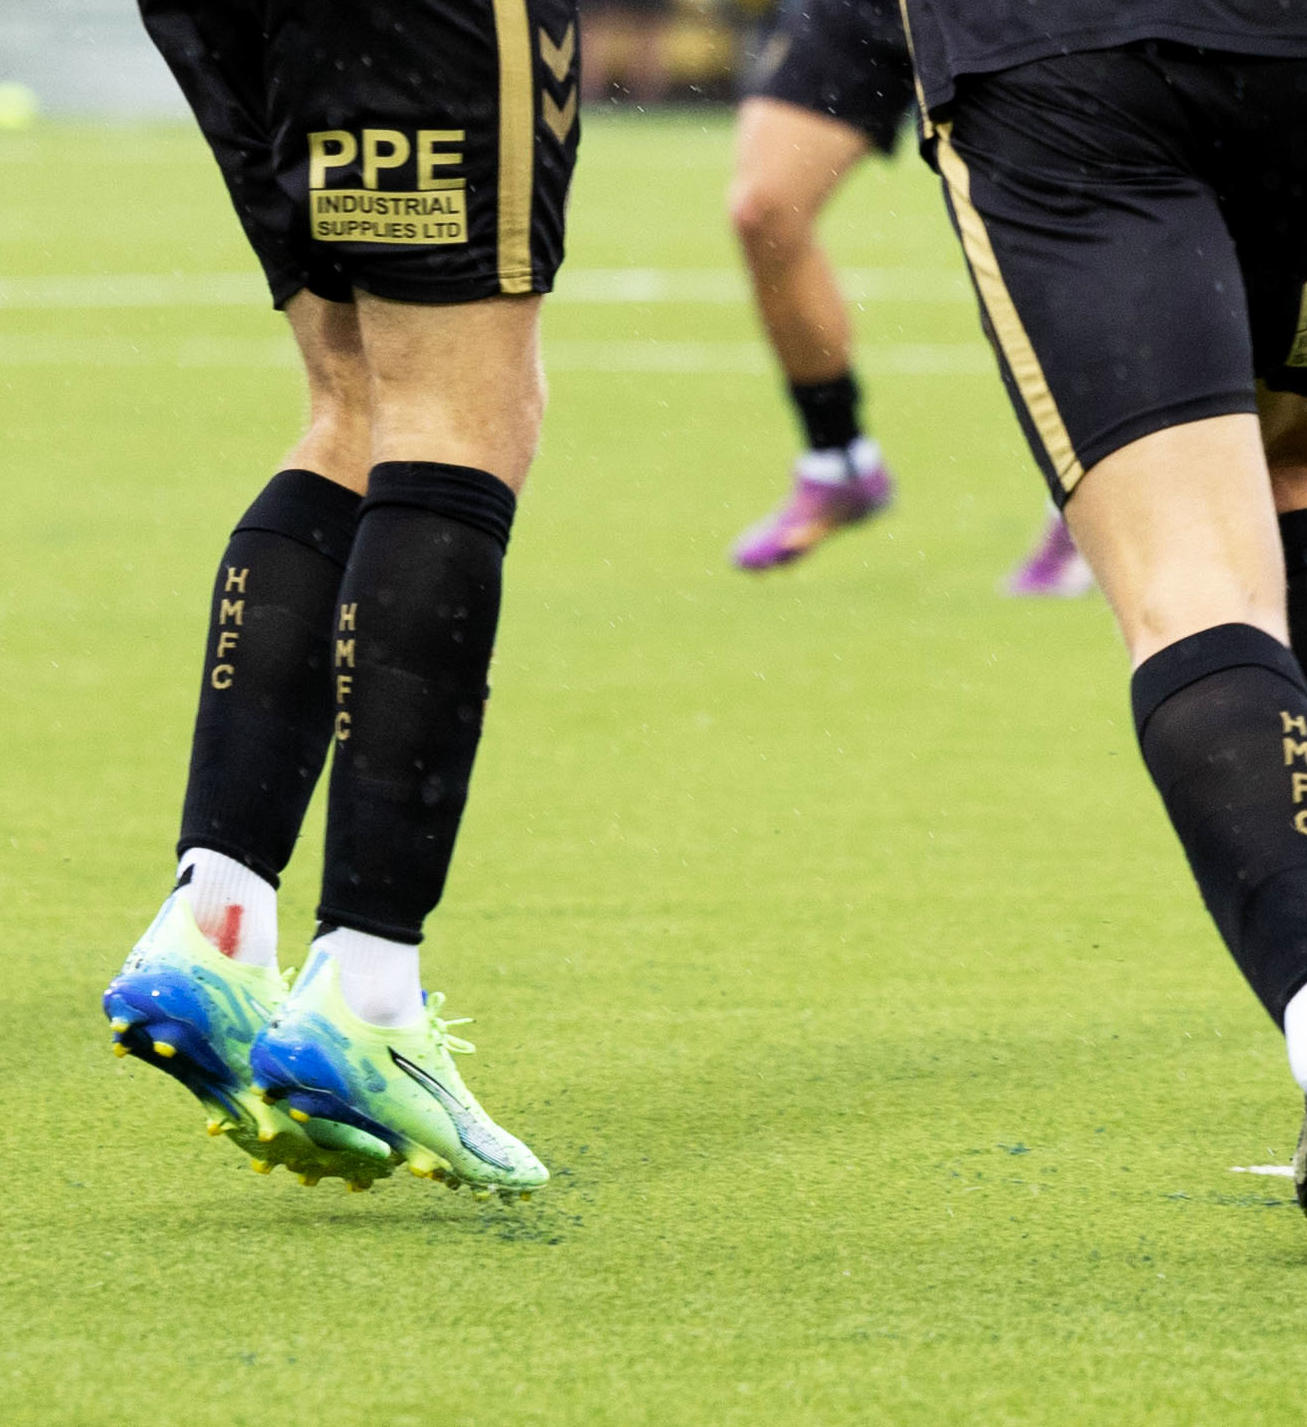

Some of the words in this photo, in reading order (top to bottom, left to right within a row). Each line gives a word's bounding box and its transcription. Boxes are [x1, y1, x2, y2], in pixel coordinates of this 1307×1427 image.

[307, 128, 466, 190] PPE
[317, 195, 460, 216] INDUSTRIAL
[317, 220, 417, 239] SUPPLIES
[424, 222, 461, 239] LTD
[211, 566, 250, 690] HMFC
[335, 602, 358, 741] HMFC
